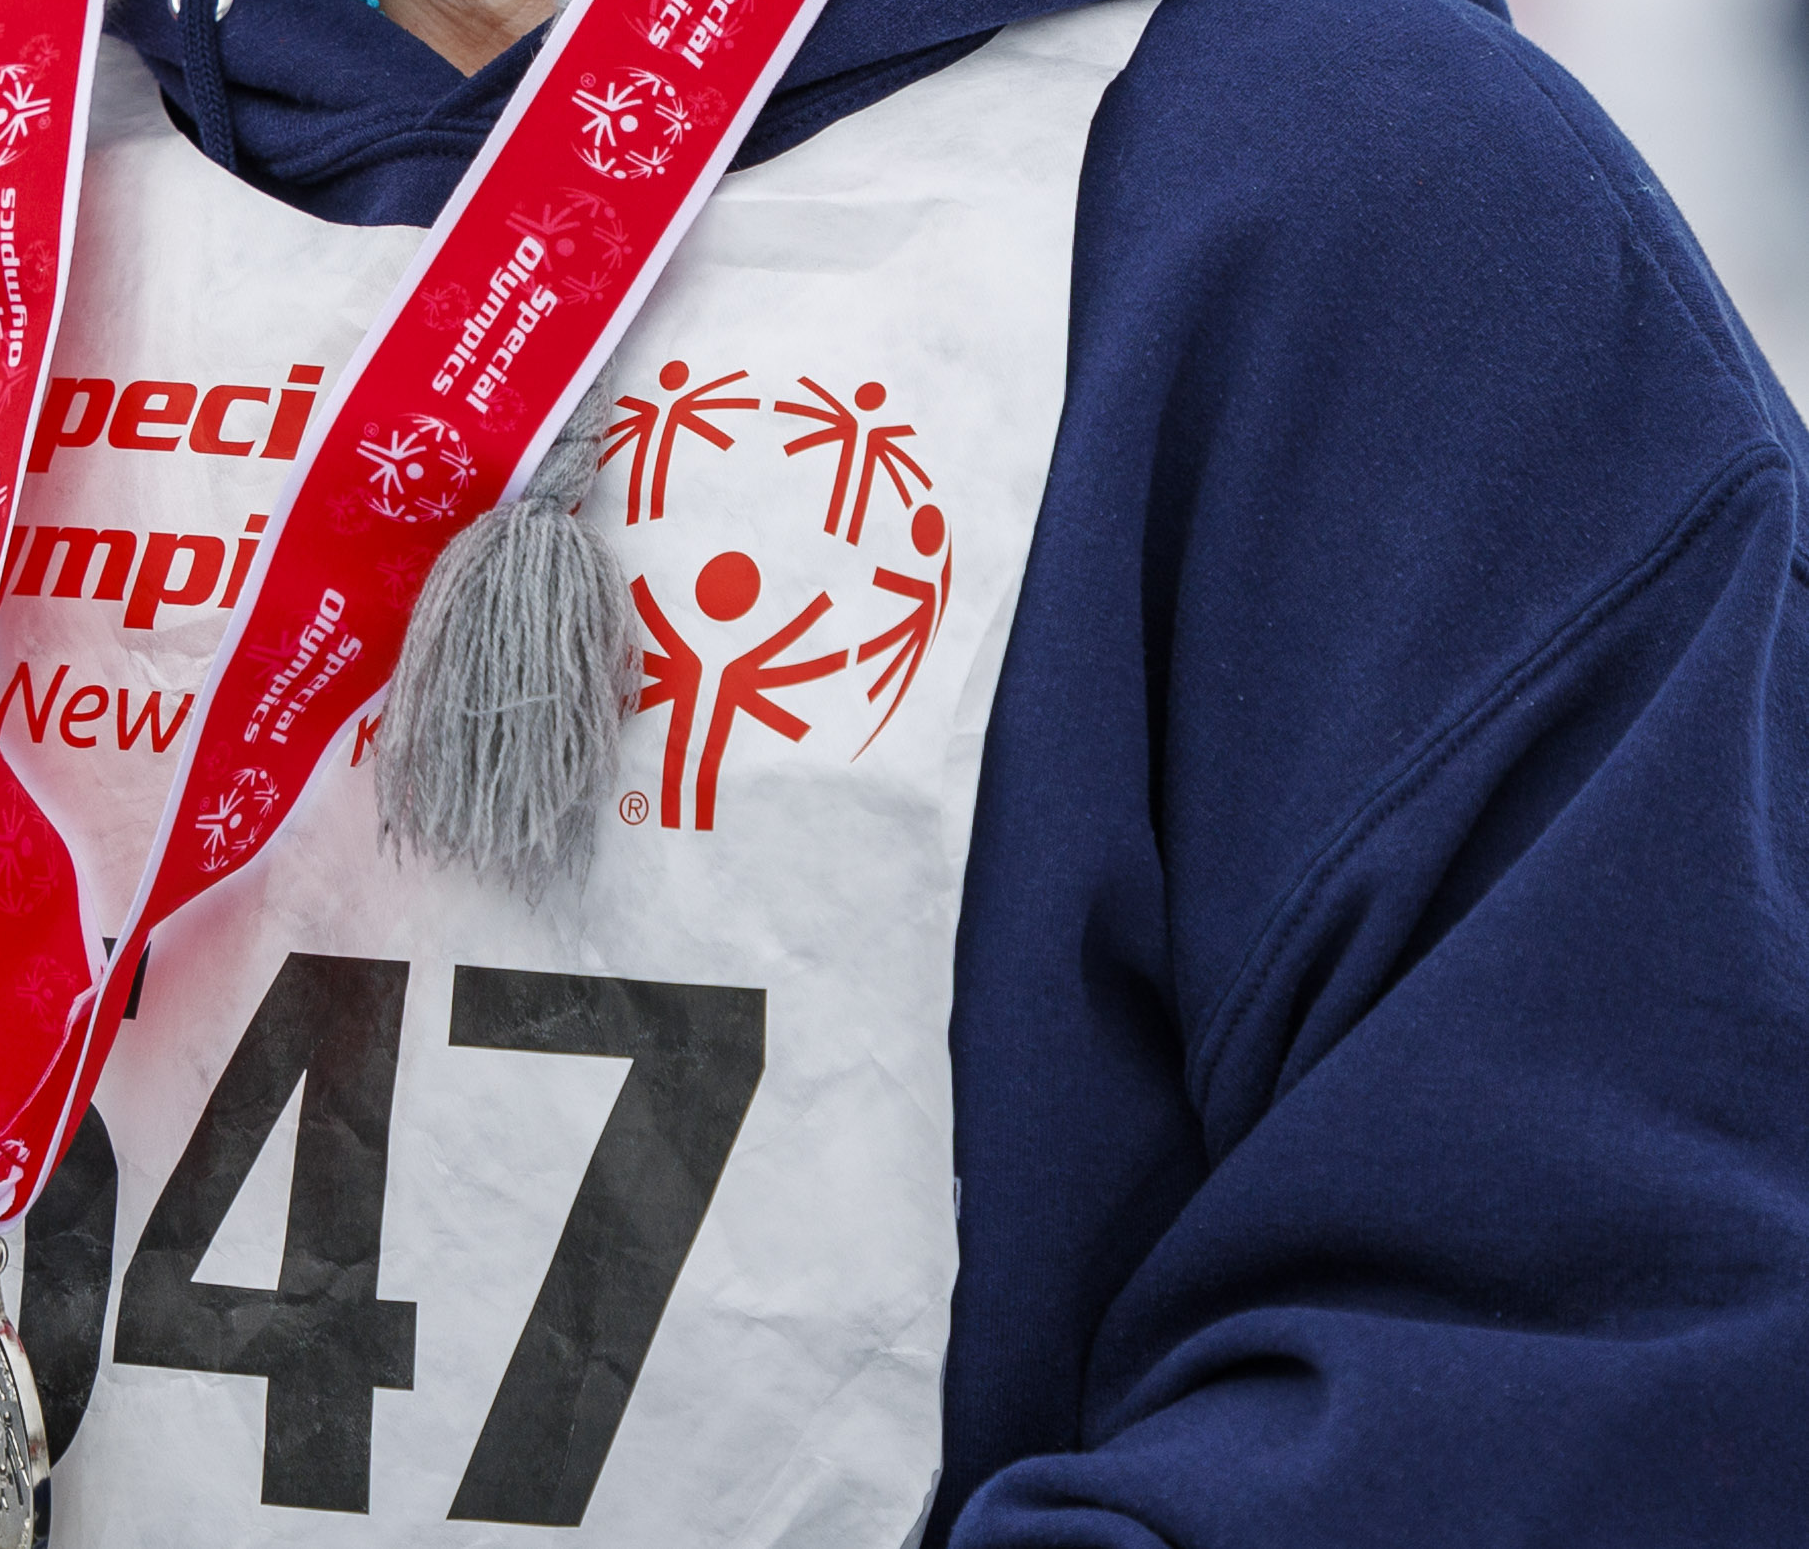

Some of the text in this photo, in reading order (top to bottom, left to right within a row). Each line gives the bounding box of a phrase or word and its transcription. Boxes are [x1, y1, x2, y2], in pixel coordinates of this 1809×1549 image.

[431, 235, 545, 396] Olympics
[465, 284, 558, 414] Special
[26, 363, 325, 473] peci
[243, 587, 347, 744] Olympics
[269, 633, 363, 745] Special
